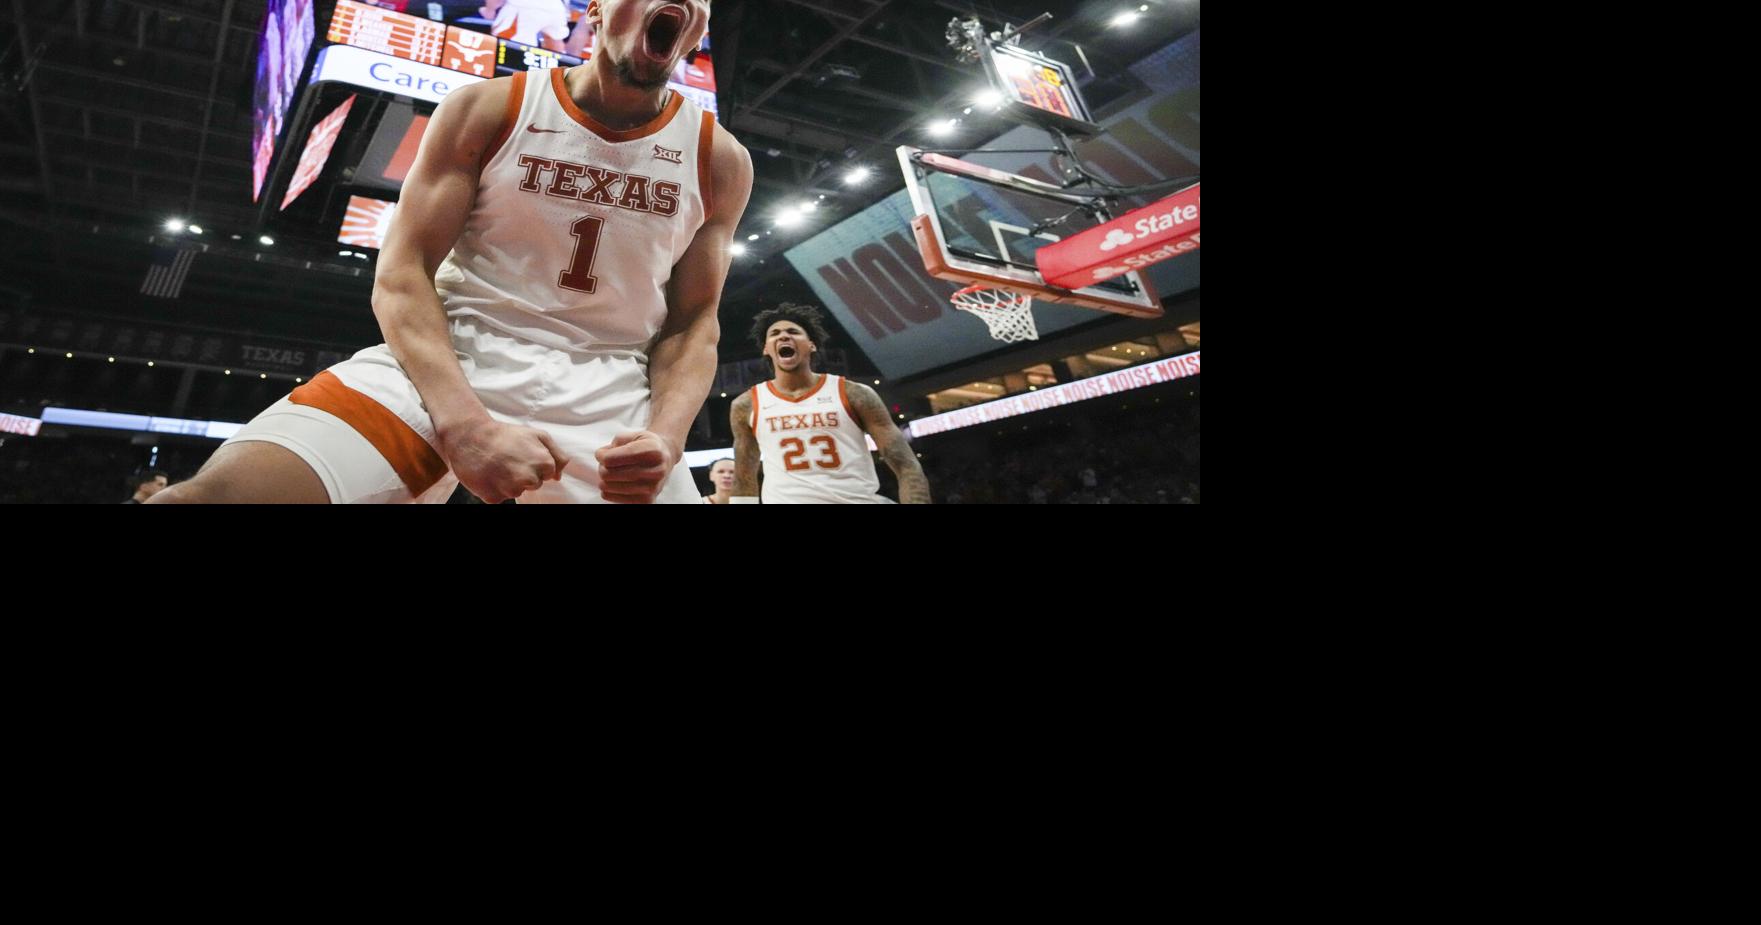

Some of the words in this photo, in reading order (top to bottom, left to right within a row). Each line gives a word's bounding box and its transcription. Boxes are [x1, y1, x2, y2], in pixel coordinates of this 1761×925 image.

[369, 62, 449, 95] Care
[518, 153, 681, 217] TEXAS
[1135, 205, 1198, 238] State
[558, 215, 604, 294] 1
[1123, 241, 1197, 268] State
[242, 345, 305, 366] TEXAS
[1021, 387, 1060, 412] NOISE
[1062, 378, 1105, 404] NOISE
[1107, 366, 1154, 393] NOISE
[1156, 353, 1200, 383] NOIS
[766, 411, 838, 432] TEXAS
[779, 434, 841, 470] 23
